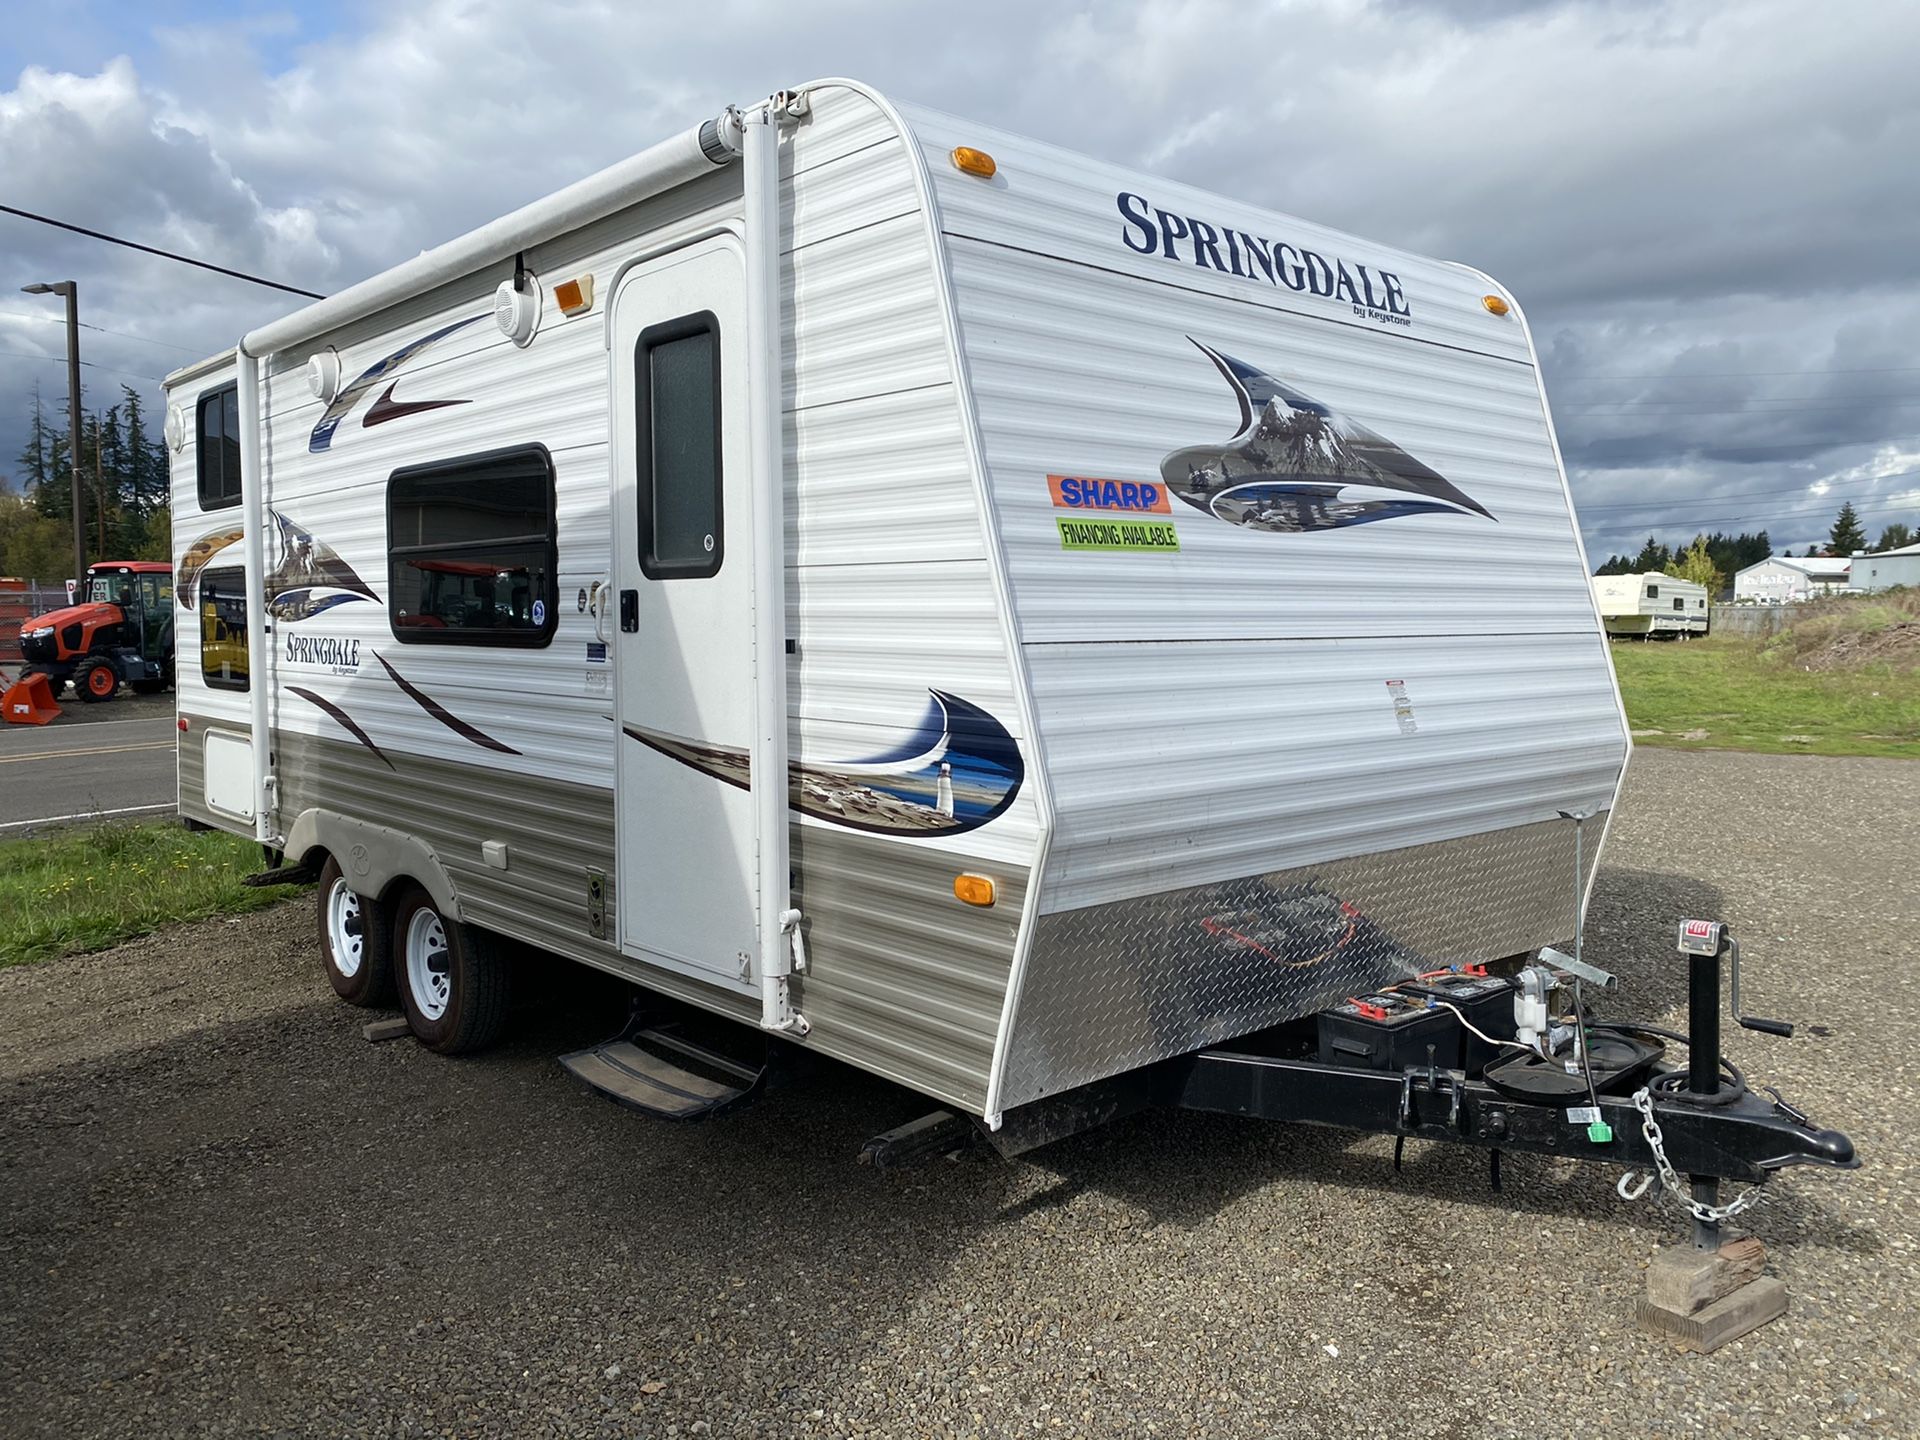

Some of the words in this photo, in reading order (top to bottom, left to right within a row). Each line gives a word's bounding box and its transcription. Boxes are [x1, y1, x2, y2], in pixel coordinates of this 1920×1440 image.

[1117, 192, 1410, 316] SPRINGDALE
[1353, 305, 1365, 318] by
[1368, 308, 1411, 327] Keystone
[1060, 478, 1159, 510] SHARP
[1061, 523, 1120, 545] FINANCING
[1122, 524, 1177, 546] AVAILABLE
[286, 632, 360, 666] SPRINGDALE
